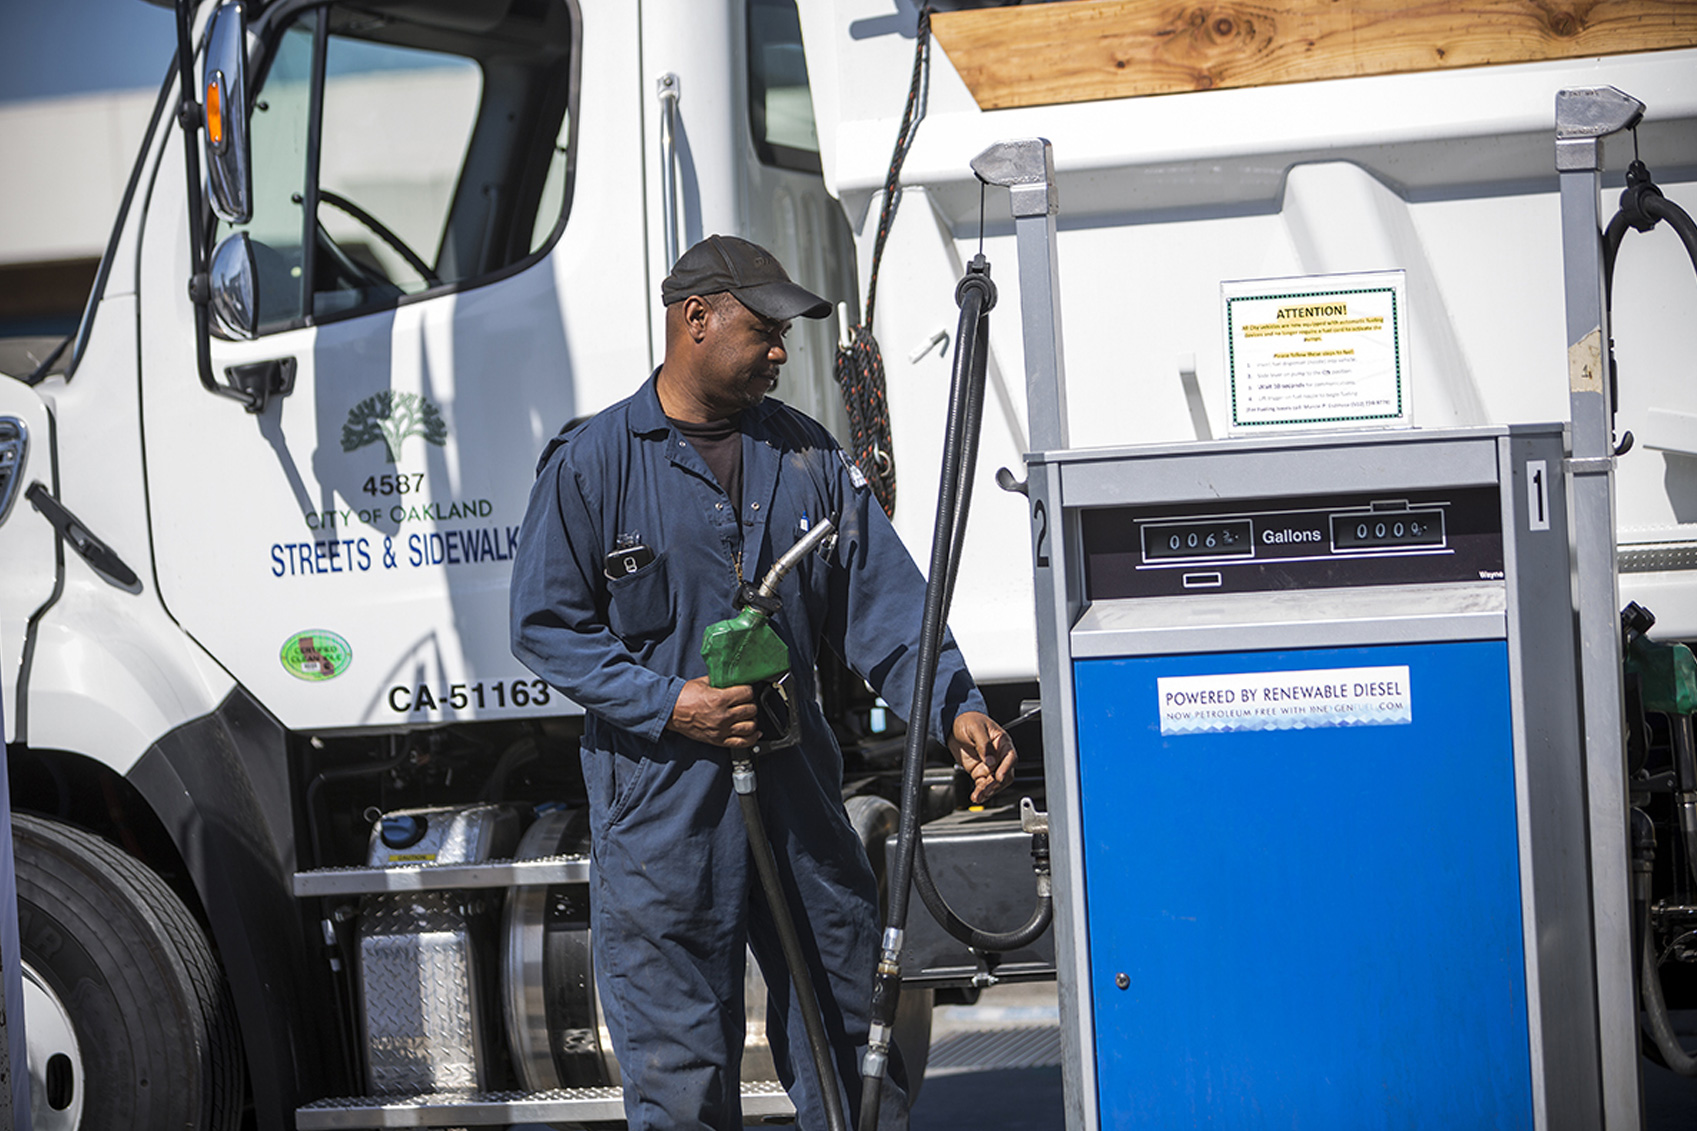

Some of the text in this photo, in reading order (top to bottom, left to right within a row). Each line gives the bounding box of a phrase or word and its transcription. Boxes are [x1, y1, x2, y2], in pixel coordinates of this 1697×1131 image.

[1277, 305, 1347, 319] ATTENTION!
[363, 473, 424, 496] 4587
[1533, 470, 1544, 522] 1
[305, 499, 493, 530] CITY OF OAKLAND
[1034, 499, 1049, 568] 2
[1262, 529, 1322, 544] Gallons
[270, 537, 371, 578] STREETS
[382, 535, 398, 569] &
[1478, 570, 1503, 579] Wayne
[388, 679, 551, 713] CA-51163
[1166, 682, 1402, 706] POWERED BY RENEWABLE DIESEL
[1167, 712, 1191, 720] NOW
[1195, 709, 1251, 719] PETROLEUM
[1255, 708, 1276, 716] FREE
[1281, 706, 1306, 714] WITH
